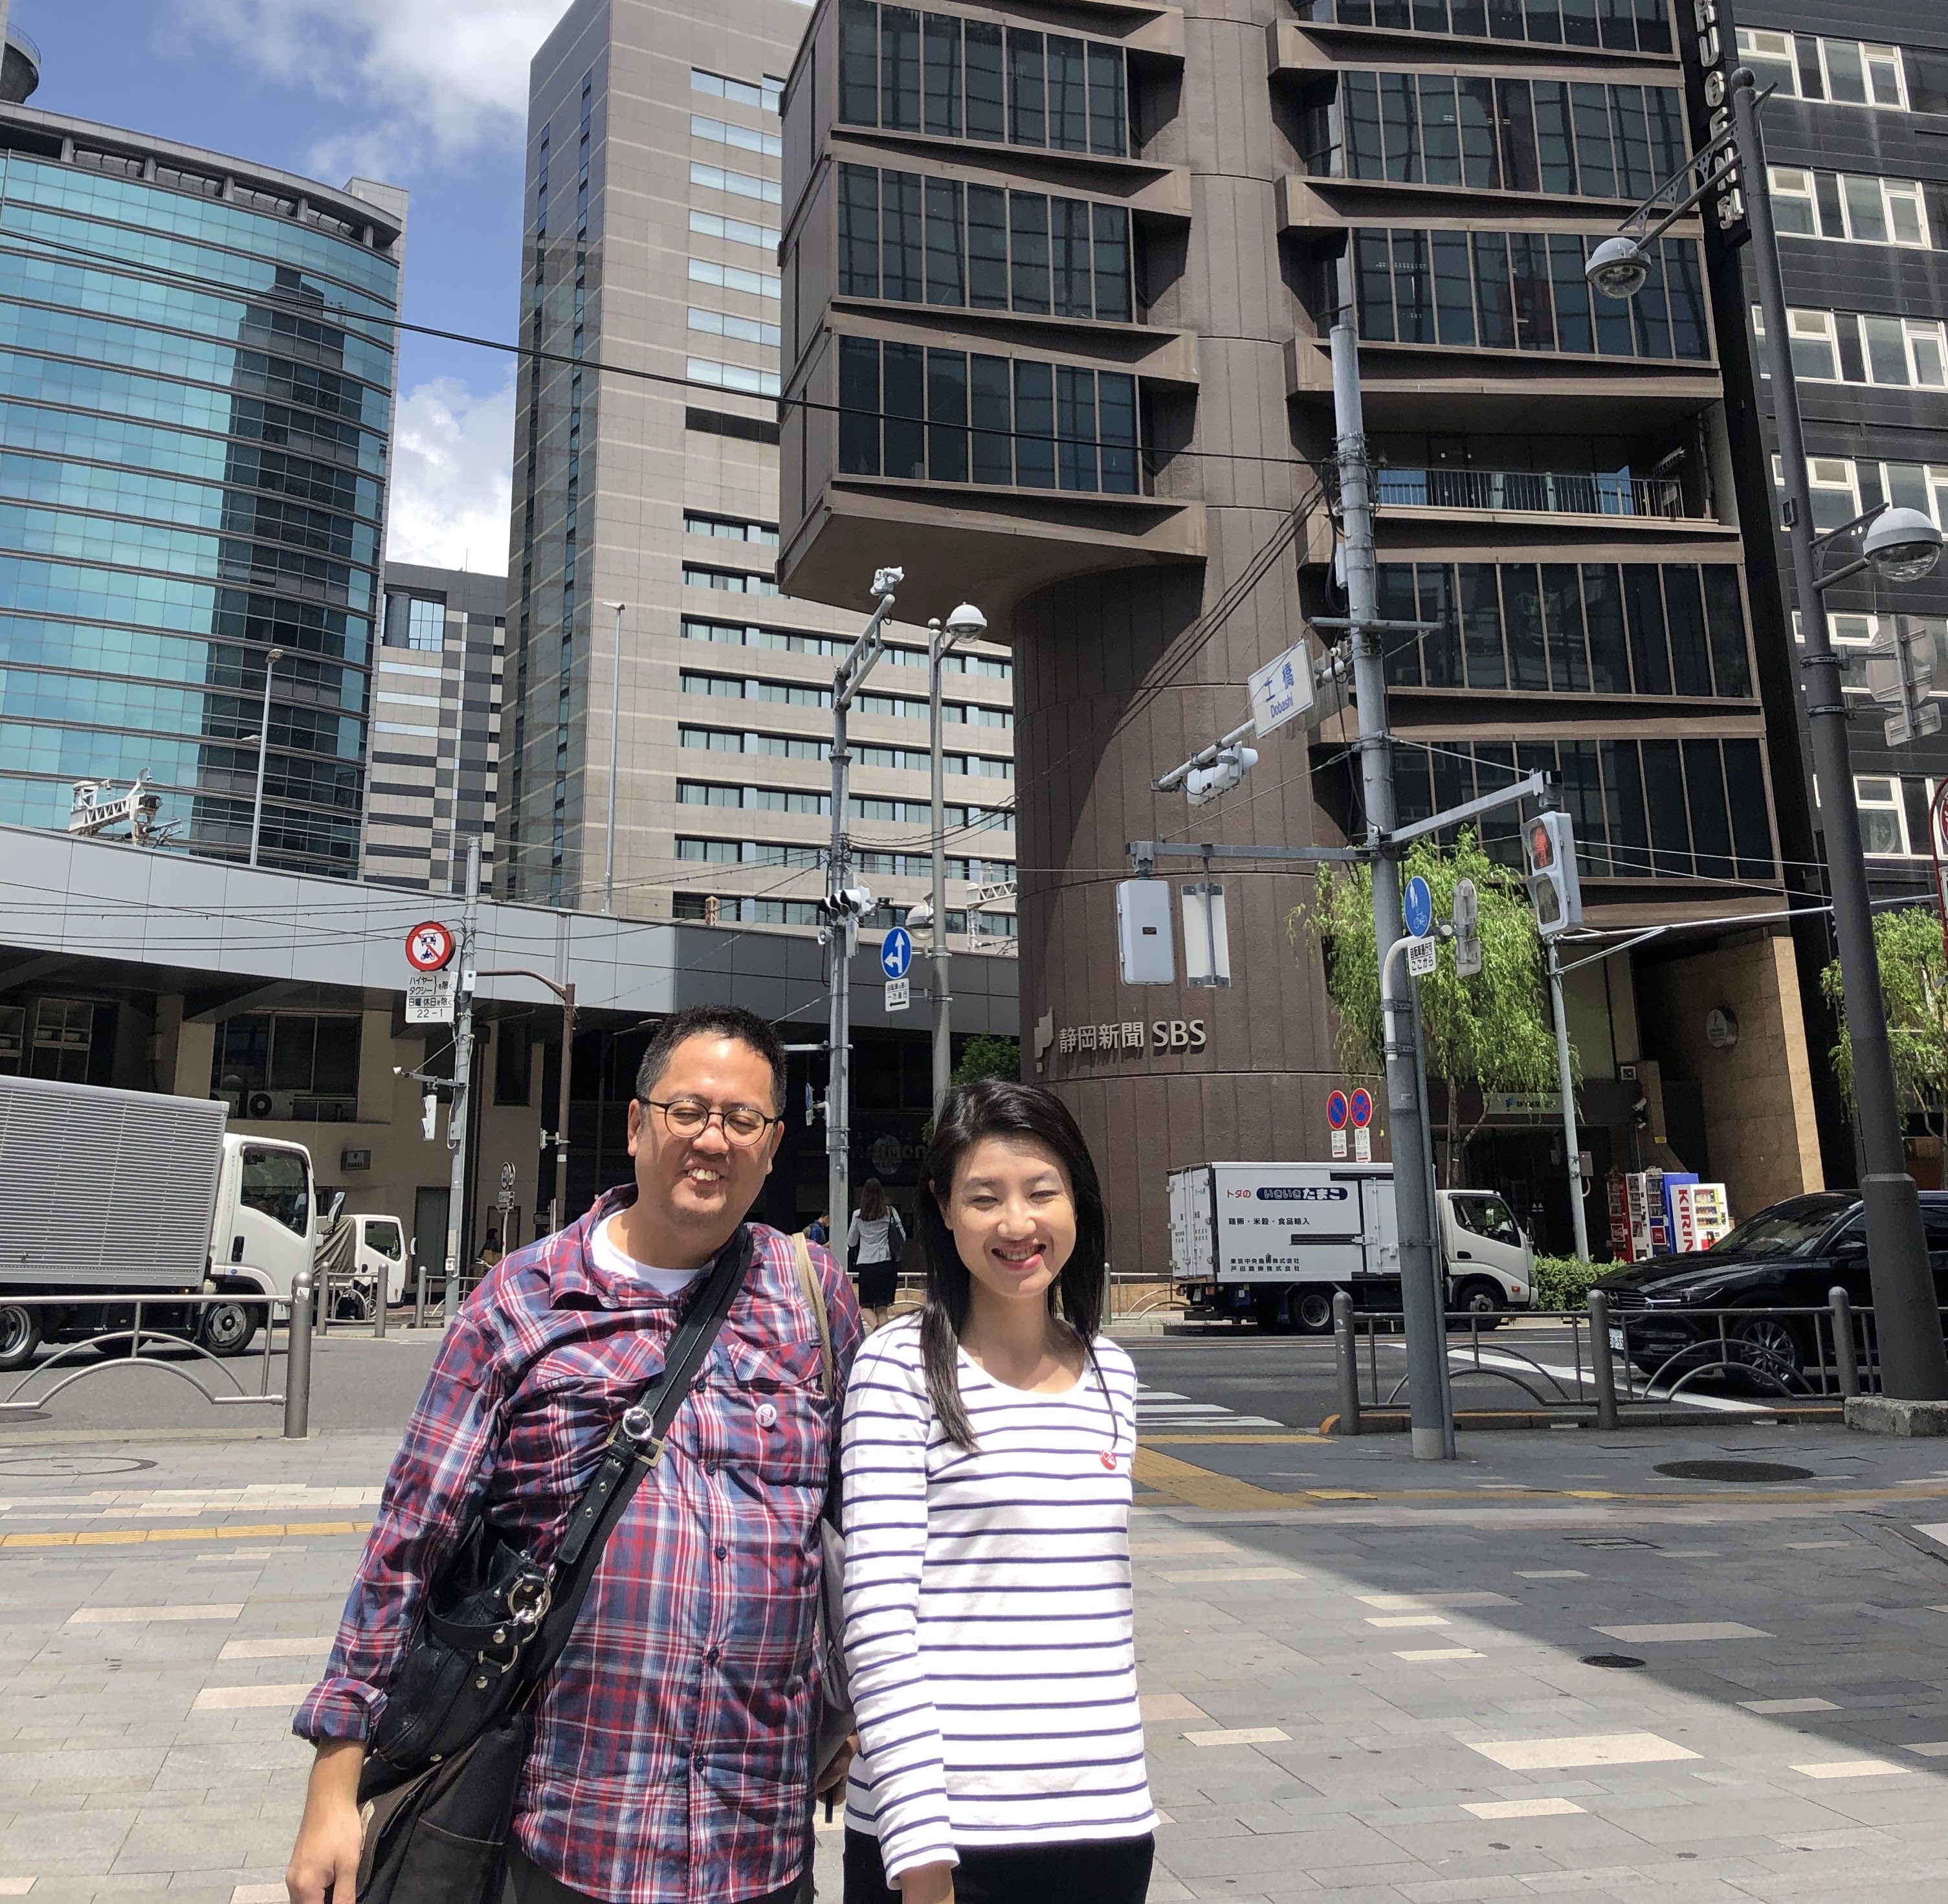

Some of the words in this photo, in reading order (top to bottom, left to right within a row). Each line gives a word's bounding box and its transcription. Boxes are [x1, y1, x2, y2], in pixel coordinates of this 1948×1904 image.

[1265, 661, 1294, 702] 土橋
[1270, 692, 1294, 718] Dobashi
[1411, 956, 1434, 971] ここから
[409, 986, 432, 995] タクシー
[410, 976, 433, 985] ハイヤー
[1059, 1021, 1144, 1054] 静岡新聞
[1152, 1019, 1207, 1047] SBS
[1226, 1189, 1251, 1199] トダの
[1678, 1189, 1694, 1252] KIRIN
